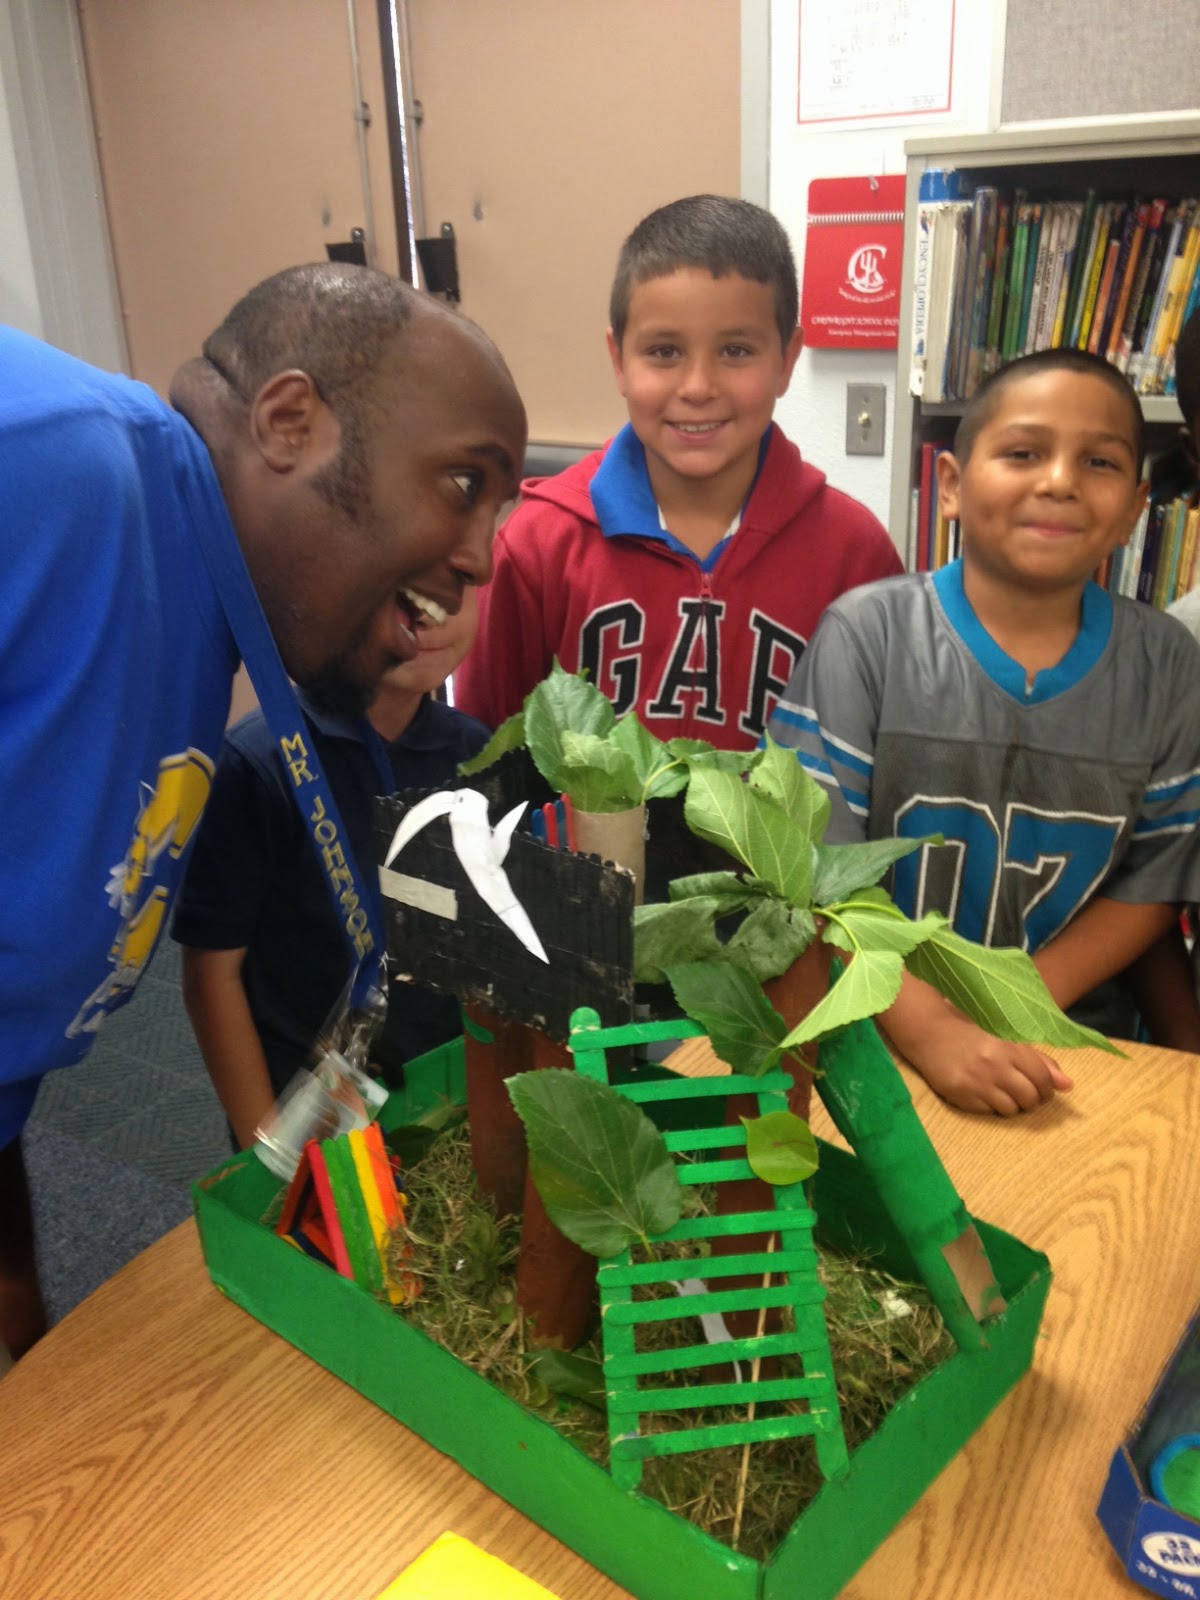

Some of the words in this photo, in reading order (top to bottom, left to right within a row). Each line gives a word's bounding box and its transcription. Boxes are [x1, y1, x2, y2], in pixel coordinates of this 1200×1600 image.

[915, 239, 930, 335] ENCYCLOPEDIA
[578, 597, 809, 738] GAP
[310, 796, 374, 961] JOHNSON
[892, 793, 1127, 954] 07
